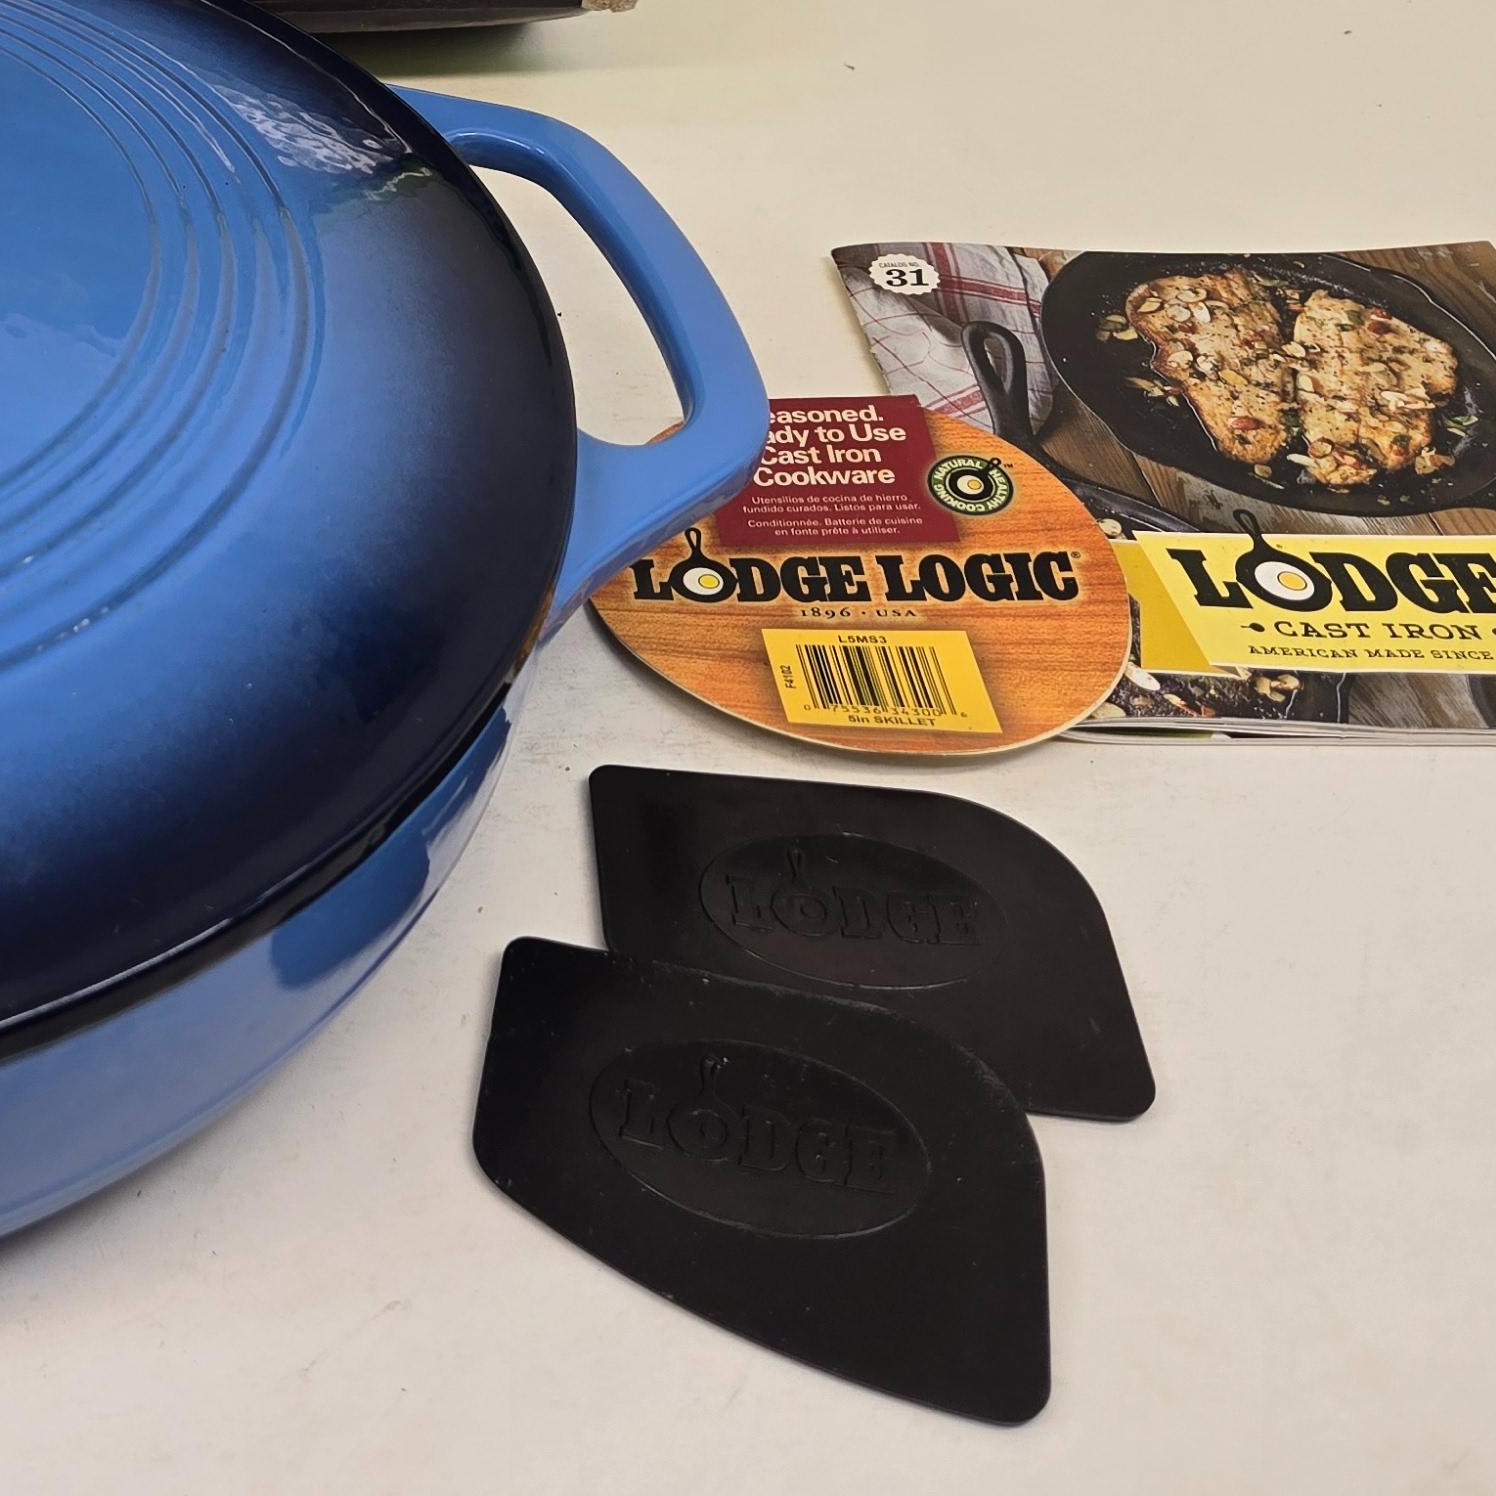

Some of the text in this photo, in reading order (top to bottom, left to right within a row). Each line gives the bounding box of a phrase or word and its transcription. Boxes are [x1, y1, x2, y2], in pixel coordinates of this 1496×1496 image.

[886, 268, 929, 287] 31
[814, 426, 844, 443] to
[849, 424, 907, 442] Use
[761, 444, 882, 465] Cast Iron
[754, 466, 896, 487] Cookware
[933, 459, 983, 480] NATURAL
[751, 496, 804, 505] Utensilios
[807, 496, 820, 504] de
[822, 495, 858, 503] cocina
[875, 494, 908, 502] hierro
[933, 469, 1008, 512] HEALTHY COOKING
[743, 505, 784, 514] fundido
[834, 504, 866, 512] Listos
[868, 504, 893, 513] para
[790, 528, 819, 536] fonte
[861, 526, 901, 535] utiliser.
[824, 518, 866, 527] Batterie
[868, 517, 882, 525] de
[884, 517, 923, 525] cuisine
[631, 528, 872, 603] LODGE
[1165, 509, 1496, 613] LODGE
[801, 607, 917, 619] 1896 USA
[838, 635, 887, 644] L5MS3
[1273, 620, 1482, 641] CAST IRON
[1249, 646, 1494, 660] AMERICAN MADE SINCE
[874, 715, 936, 727] SKILLET
